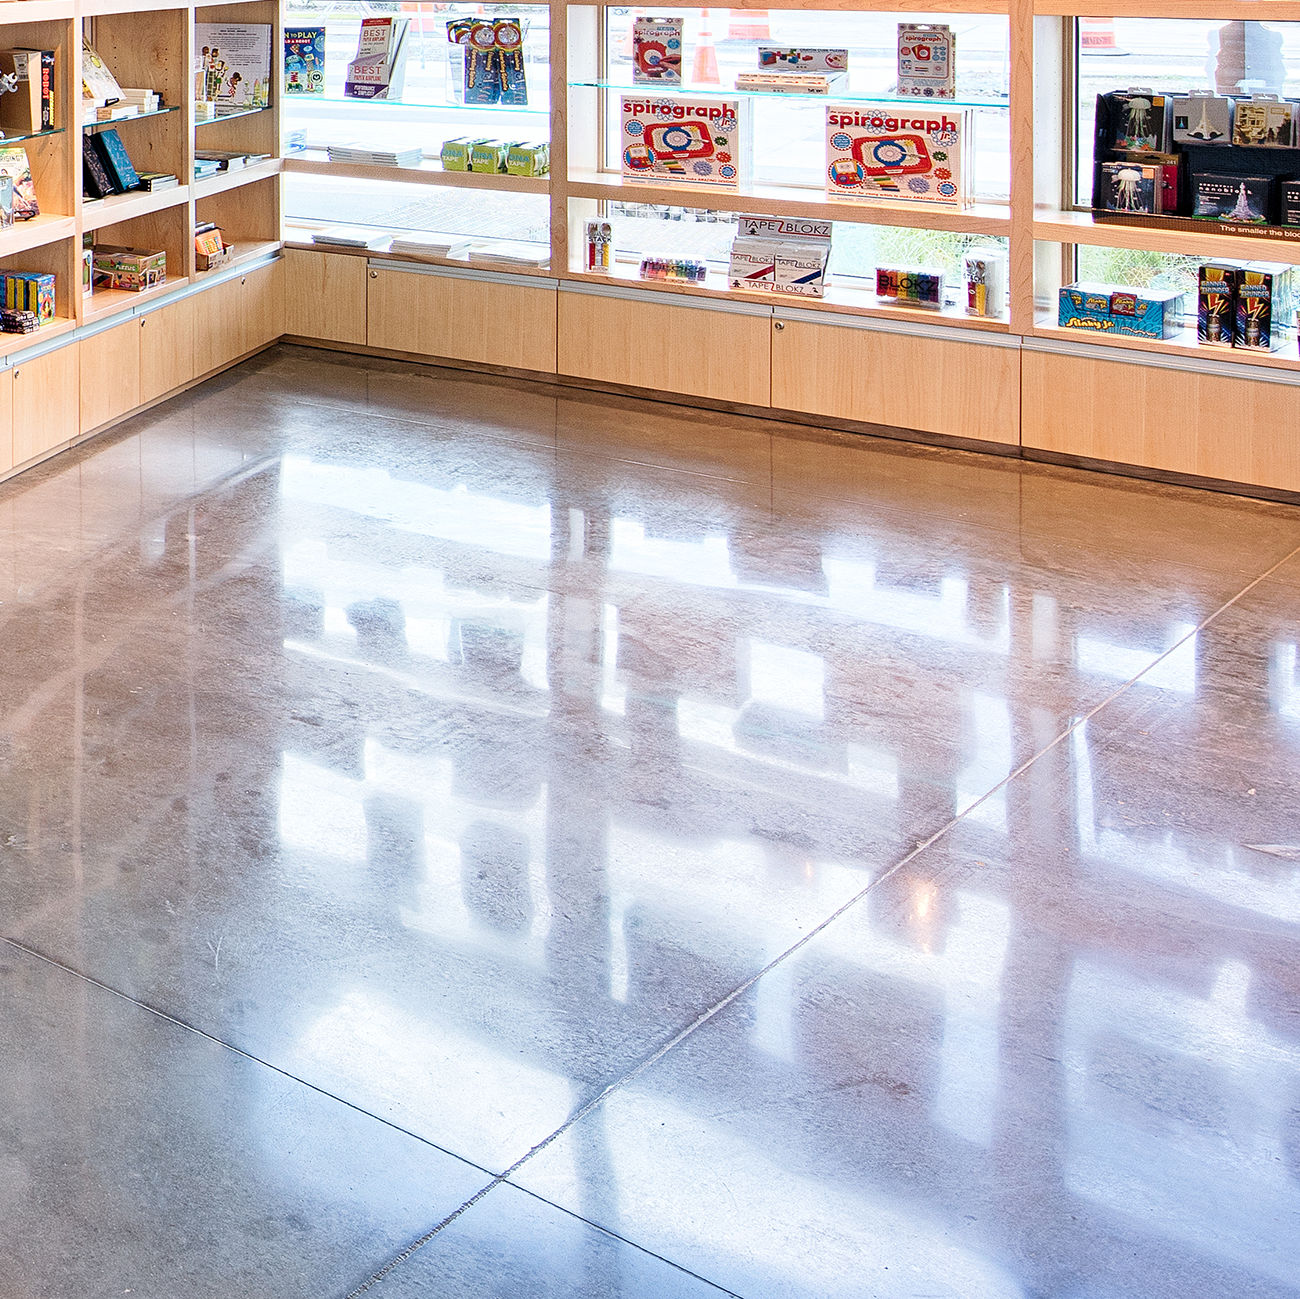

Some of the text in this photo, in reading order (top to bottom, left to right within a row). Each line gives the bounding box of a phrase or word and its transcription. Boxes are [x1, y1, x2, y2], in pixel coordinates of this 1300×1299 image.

[297, 31, 317, 39] PLAY
[363, 29, 386, 37] BEST
[634, 29, 680, 38] spirograph
[354, 65, 382, 74] BEST
[42, 67, 50, 100] ROBOT
[623, 100, 735, 121] spirograph
[721, 118, 731, 127] jr.
[828, 111, 956, 134] spirograph
[940, 131, 951, 141] jr.
[442, 149, 464, 157] DNA
[473, 151, 494, 160] DNA
[509, 153, 530, 162] DNA
[1198, 186, 1253, 195] nanoblok
[744, 219, 830, 235] TAPE BLOKZ
[1220, 224, 1283, 237] The smaller the
[752, 256, 773, 264] BLOKZ
[798, 261, 821, 269] BLOKZ
[748, 282, 804, 293] TAPE BLOKZ
[878, 275, 937, 292] BLOKZ
[1240, 290, 1270, 298] THUNDER
[1065, 317, 1102, 329] Slinky
[1102, 319, 1115, 329] Jr.
